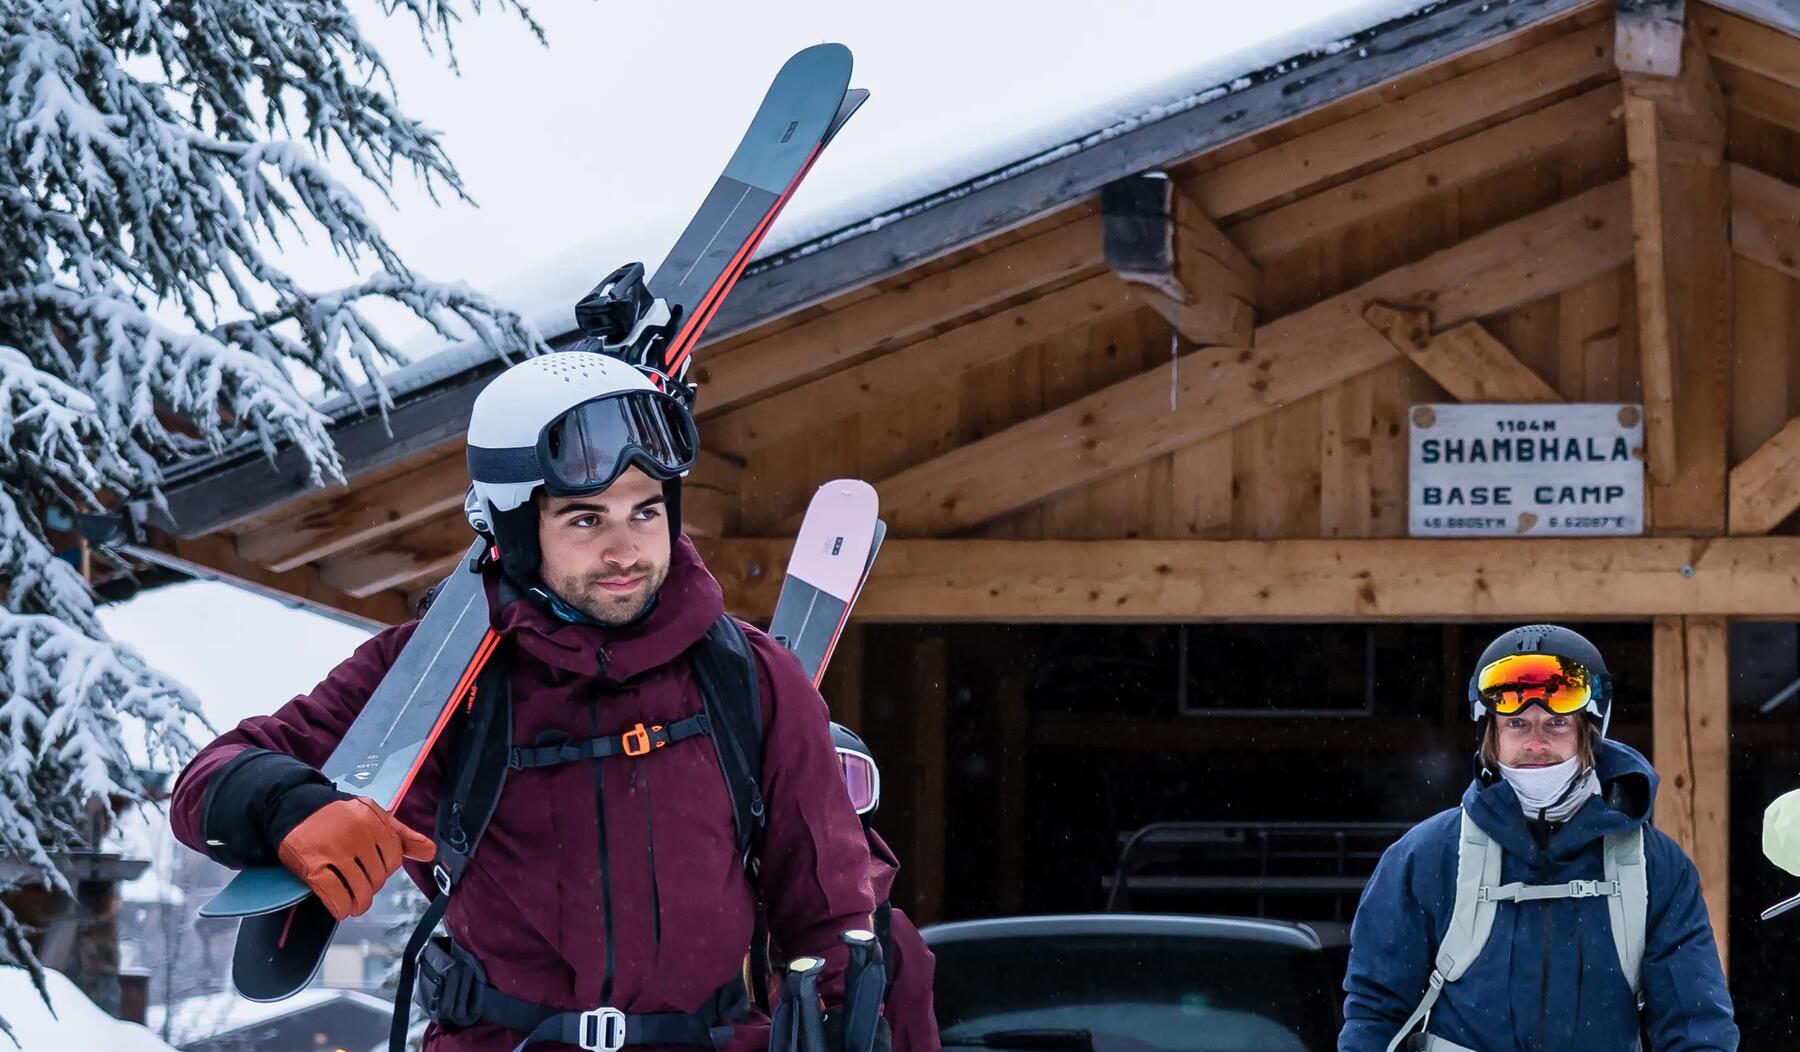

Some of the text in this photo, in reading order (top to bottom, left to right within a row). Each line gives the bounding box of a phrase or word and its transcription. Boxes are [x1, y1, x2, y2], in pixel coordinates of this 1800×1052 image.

[1421, 437, 1629, 464] SHAMBHALA
[1422, 485, 1625, 505] BASE CAMP
